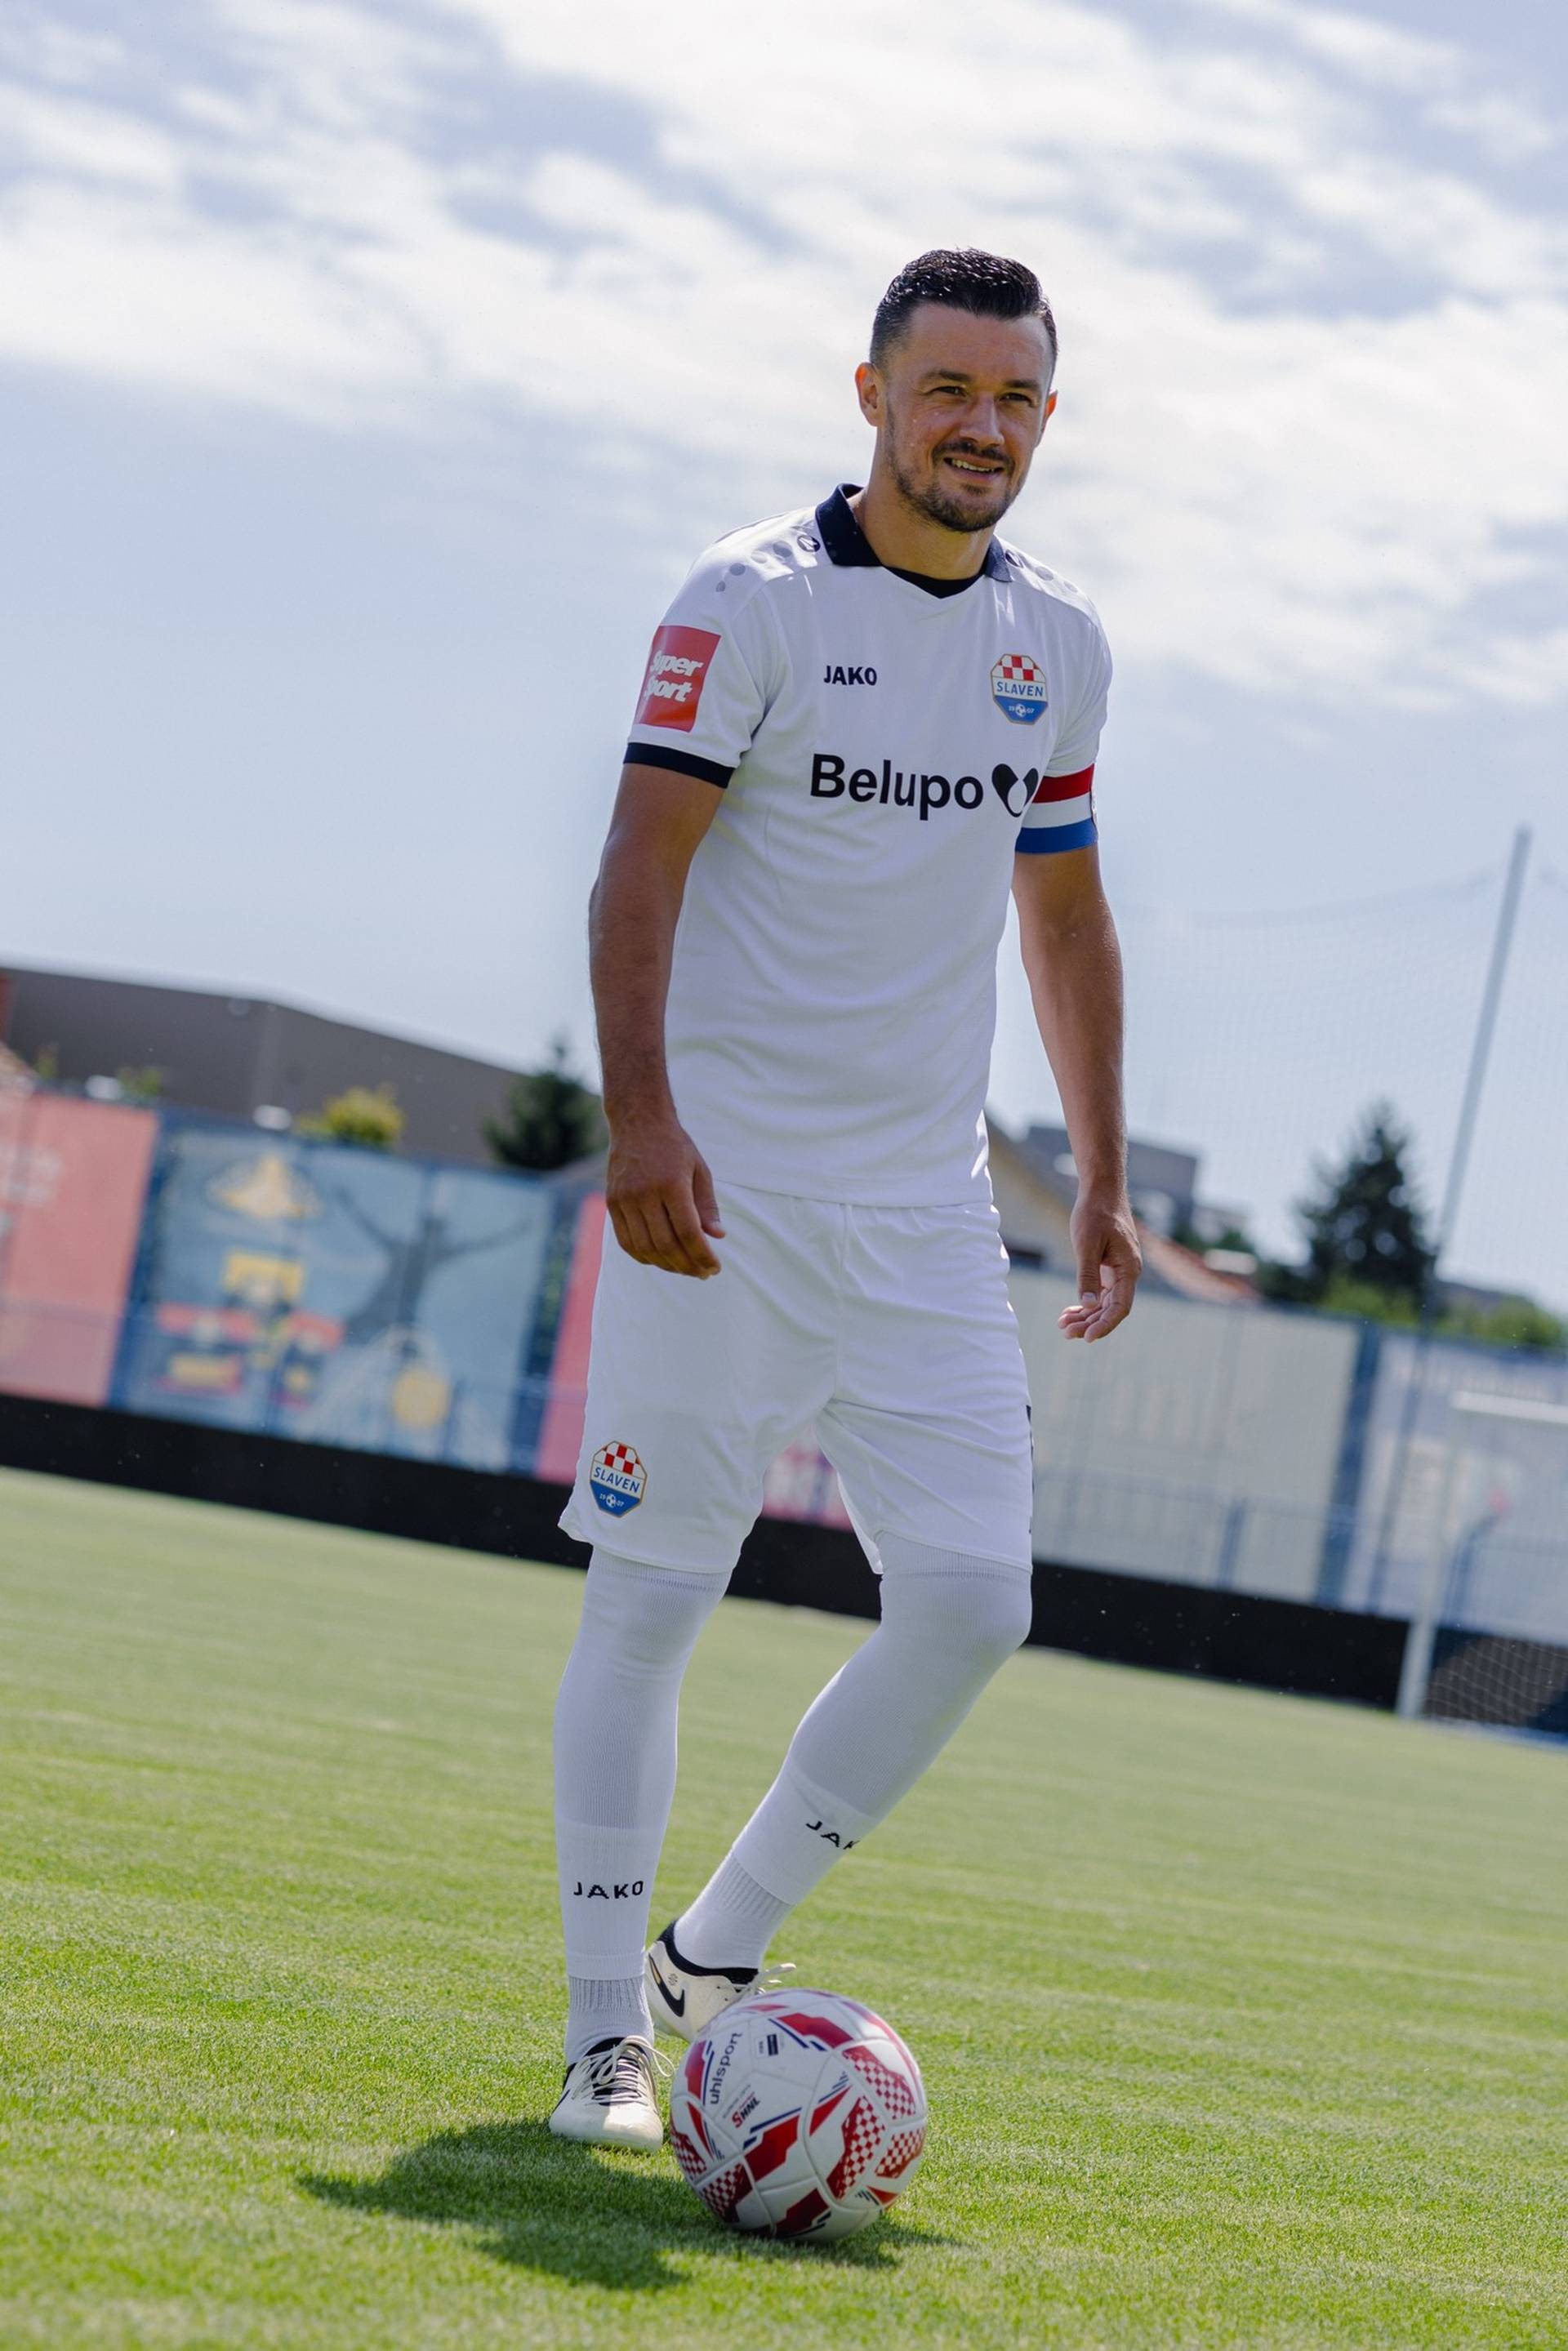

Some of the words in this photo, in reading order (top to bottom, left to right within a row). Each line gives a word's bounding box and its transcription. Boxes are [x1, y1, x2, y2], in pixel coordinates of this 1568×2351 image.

[824, 666, 877, 686] JAKO
[996, 681, 1043, 697] SLAVEN
[810, 753, 984, 822] Belupo
[593, 1467, 640, 1493] SLAVEN
[805, 1820, 861, 1850] JAK
[573, 1881, 644, 1899] JAKO
[710, 2032, 743, 2104] uhlsport
